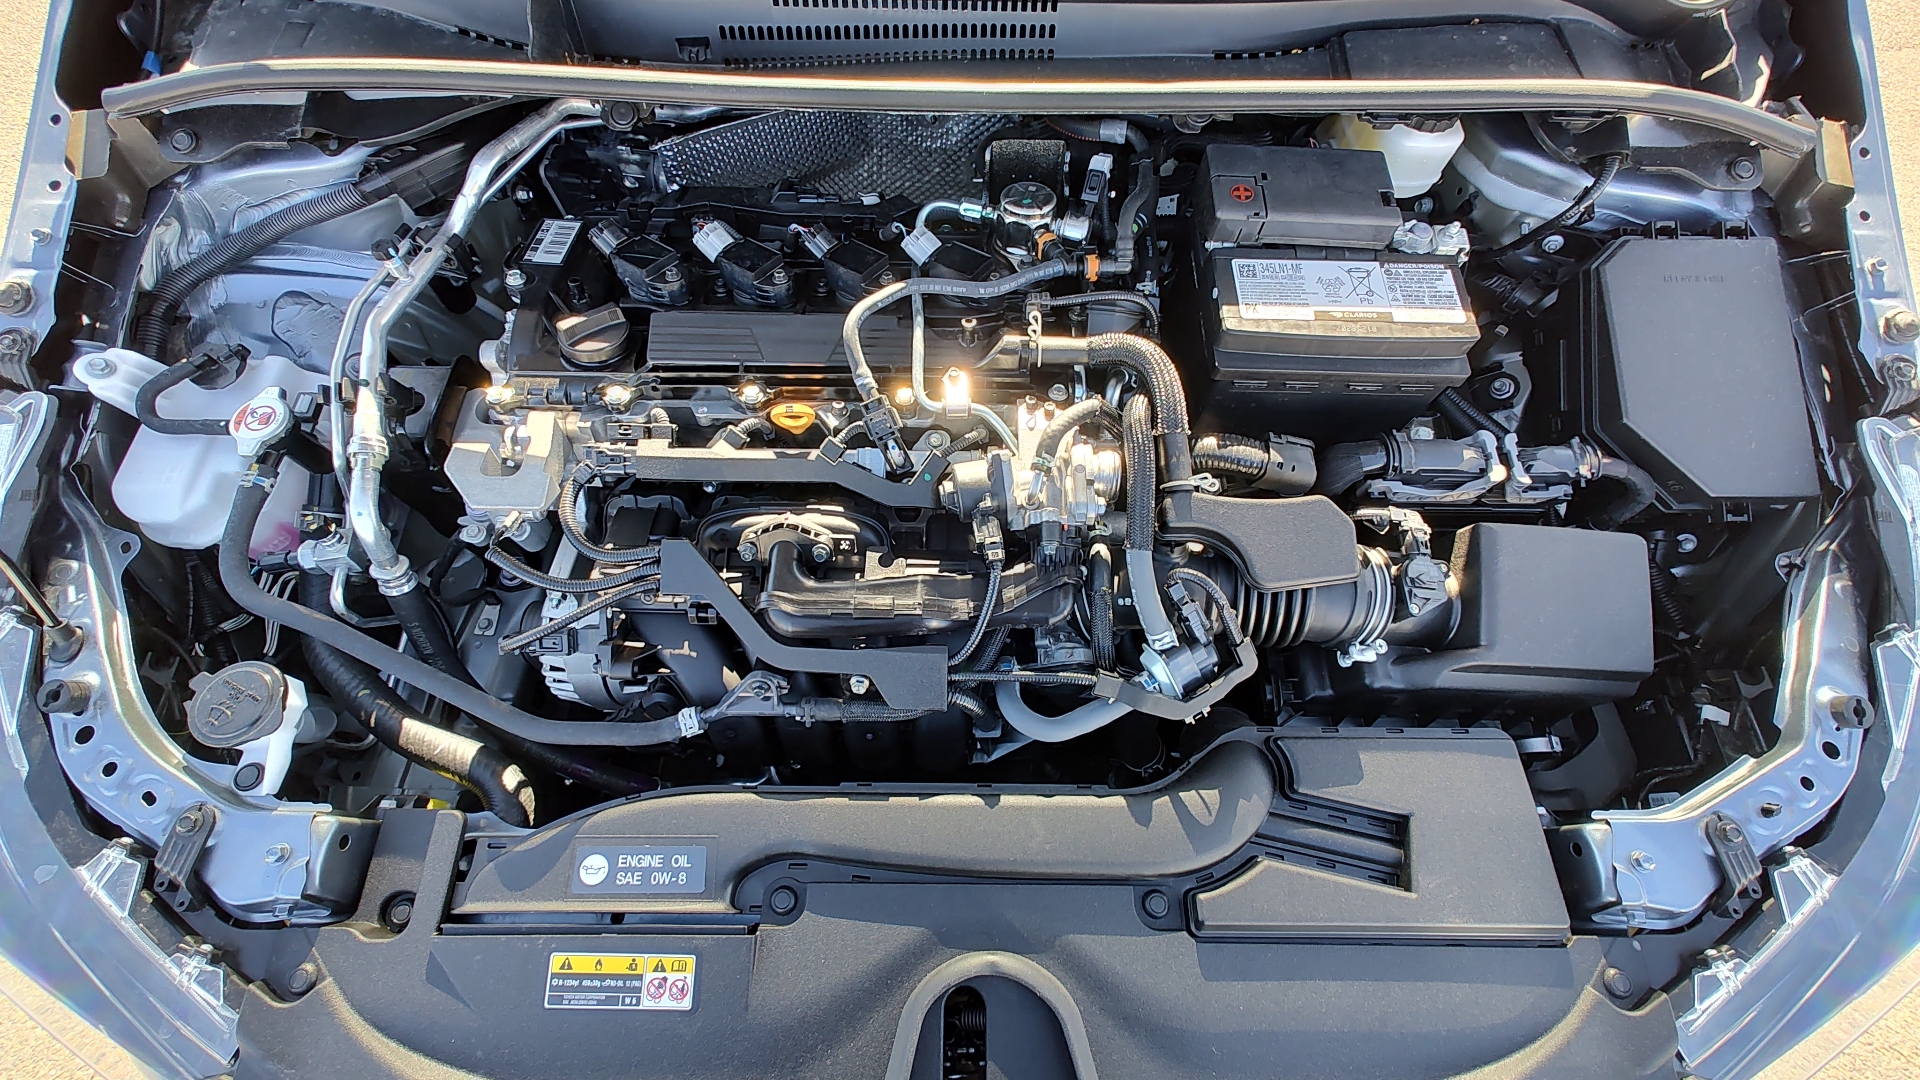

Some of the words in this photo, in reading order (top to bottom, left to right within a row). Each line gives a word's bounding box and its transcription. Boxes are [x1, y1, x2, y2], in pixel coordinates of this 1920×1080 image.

[1260, 263, 1303, 274] 345LN1-MF
[1359, 297, 1374, 305] Pb
[617, 854, 664, 868] ENGINE
[671, 854, 692, 868] OIL
[615, 871, 643, 885] SAE
[650, 871, 687, 885] 0W-8
